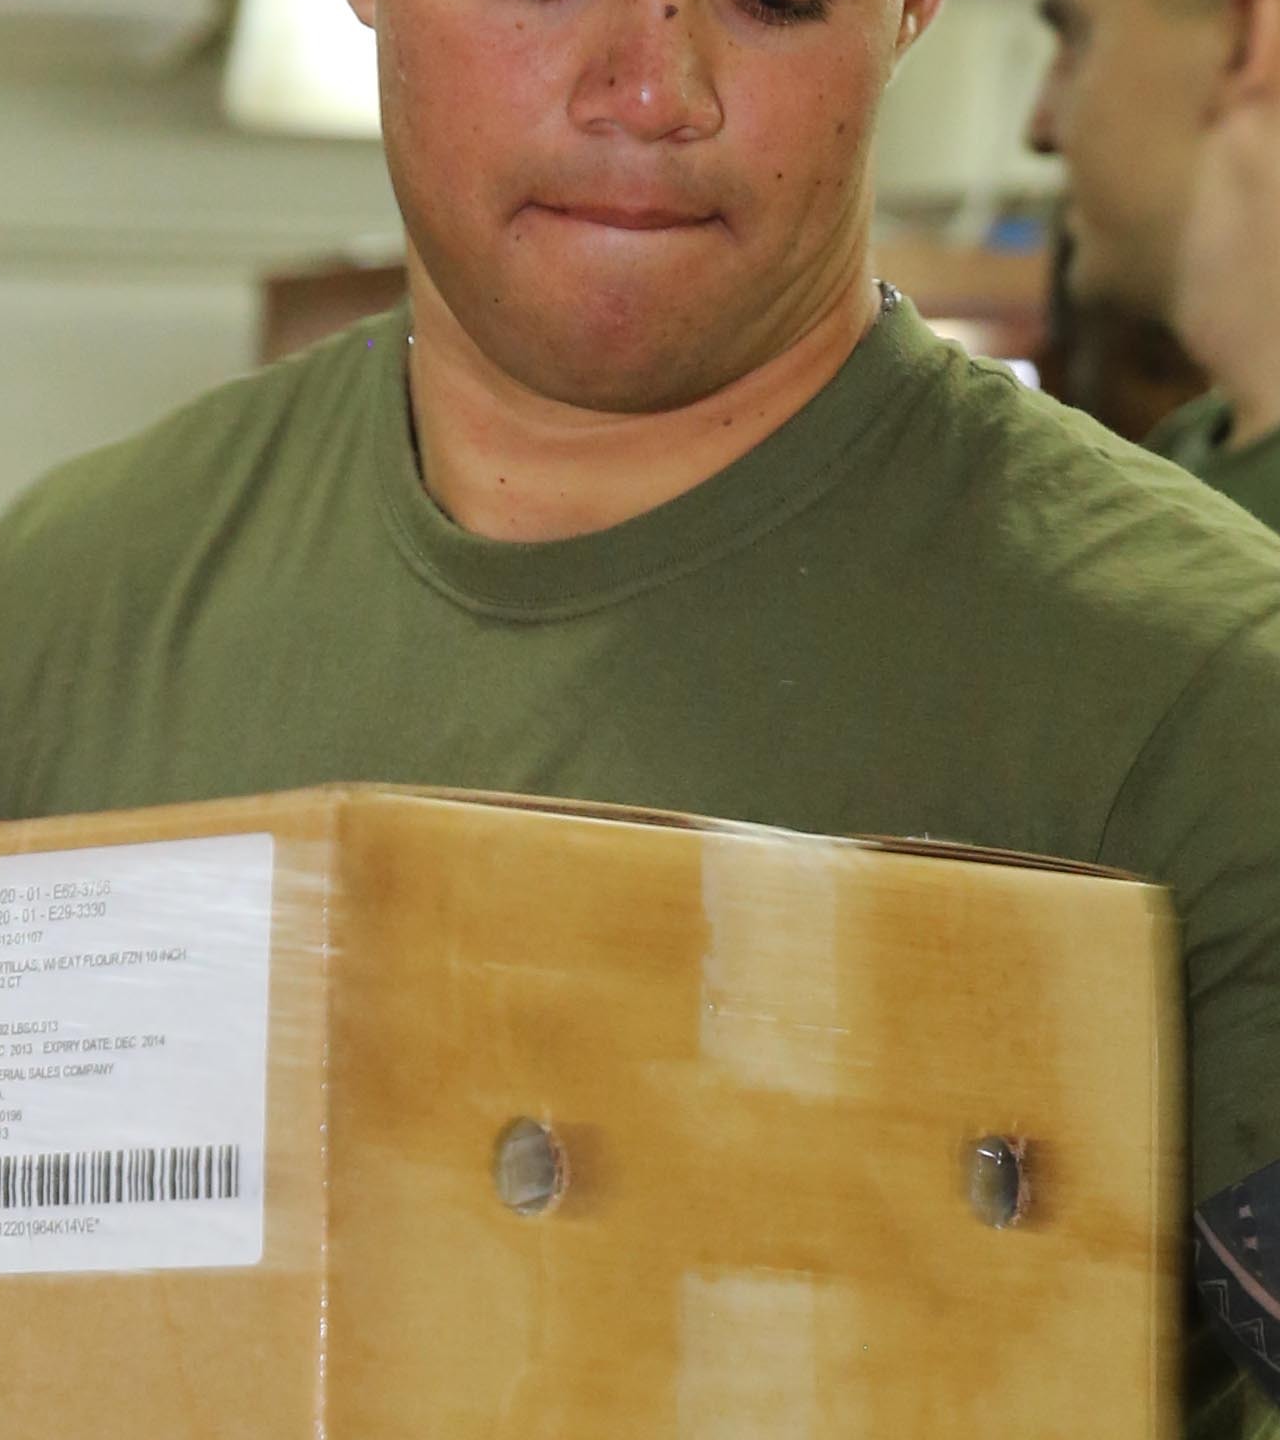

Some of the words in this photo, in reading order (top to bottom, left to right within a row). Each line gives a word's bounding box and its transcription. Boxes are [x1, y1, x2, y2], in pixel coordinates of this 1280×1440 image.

[26, 887, 40, 902] 01
[22, 908, 36, 923] 01
[42, 956, 81, 972] WHEAT
[7, 975, 22, 989] CT
[10, 1043, 33, 1057] 2013
[42, 1039, 80, 1054] EXPIRY
[115, 1035, 137, 1050] DEC
[141, 1034, 166, 1048] 2014
[28, 1065, 60, 1080] SALES
[62, 1063, 114, 1078] COMPANY
